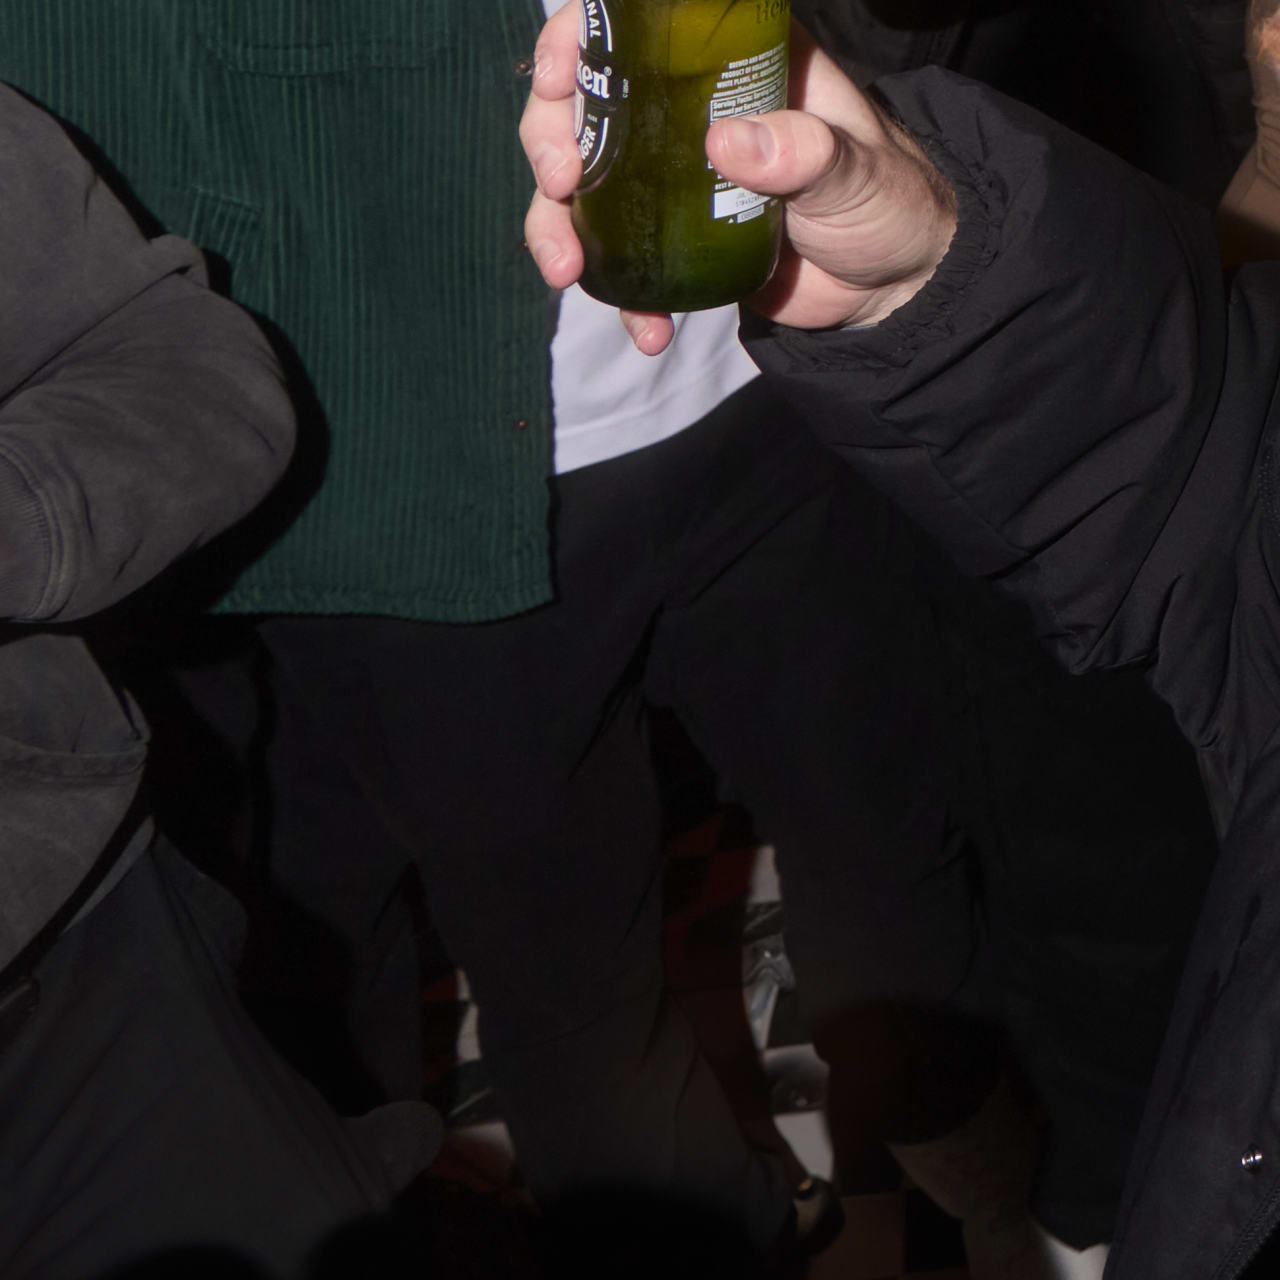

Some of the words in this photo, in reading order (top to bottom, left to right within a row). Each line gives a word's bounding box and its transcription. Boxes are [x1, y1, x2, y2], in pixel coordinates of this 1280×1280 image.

[721, 68, 745, 80] PRODUCT
[713, 98, 737, 110] Serving
[713, 107, 735, 118] Amount
